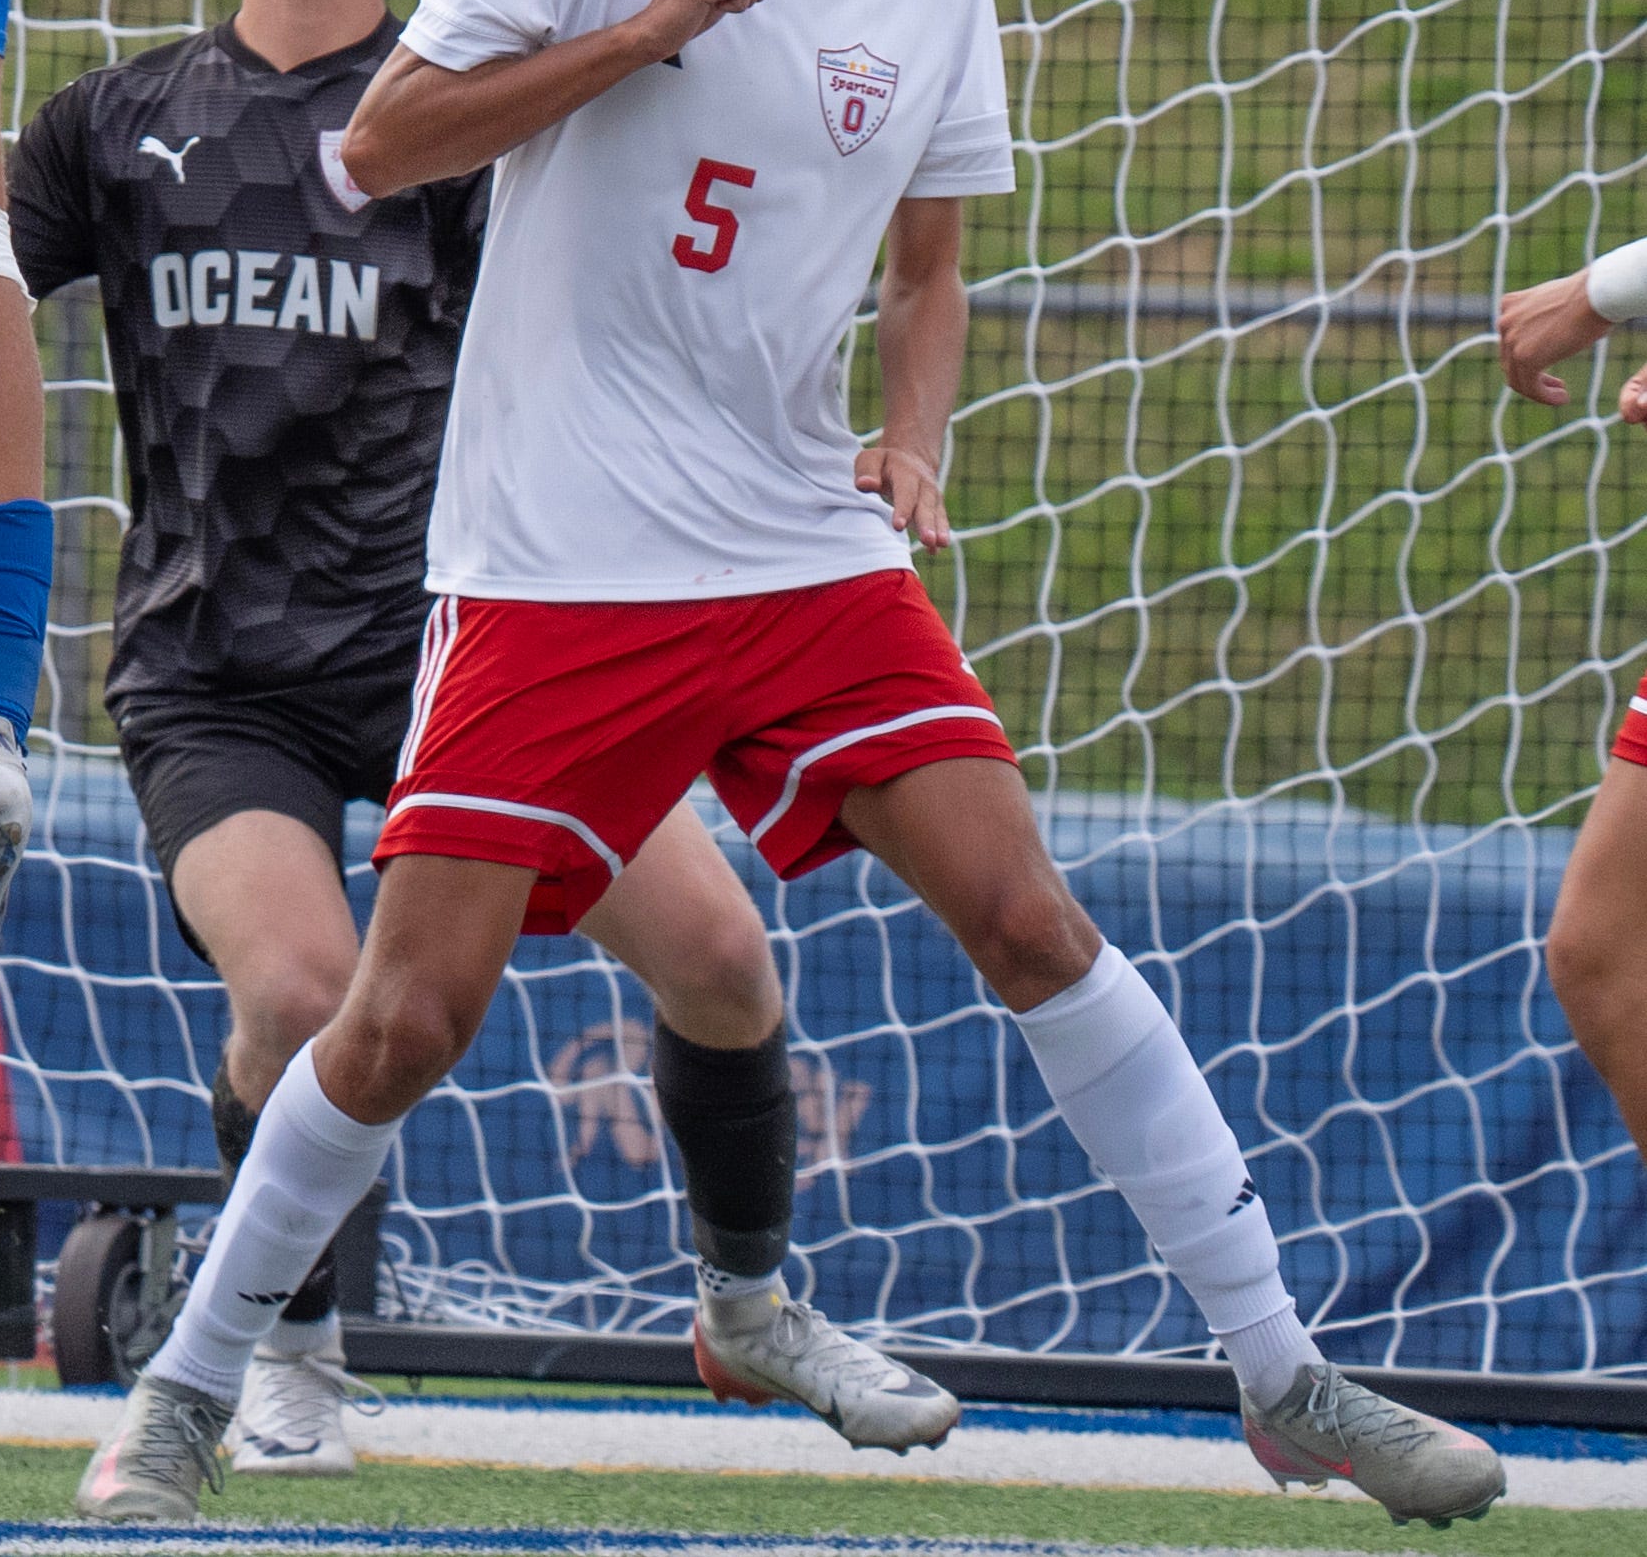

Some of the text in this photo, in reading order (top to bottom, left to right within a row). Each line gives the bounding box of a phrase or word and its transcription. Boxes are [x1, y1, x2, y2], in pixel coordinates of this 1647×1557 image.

[830, 75, 888, 99] Spartans
[671, 157, 757, 273] 5
[150, 249, 381, 341] OCEAN
